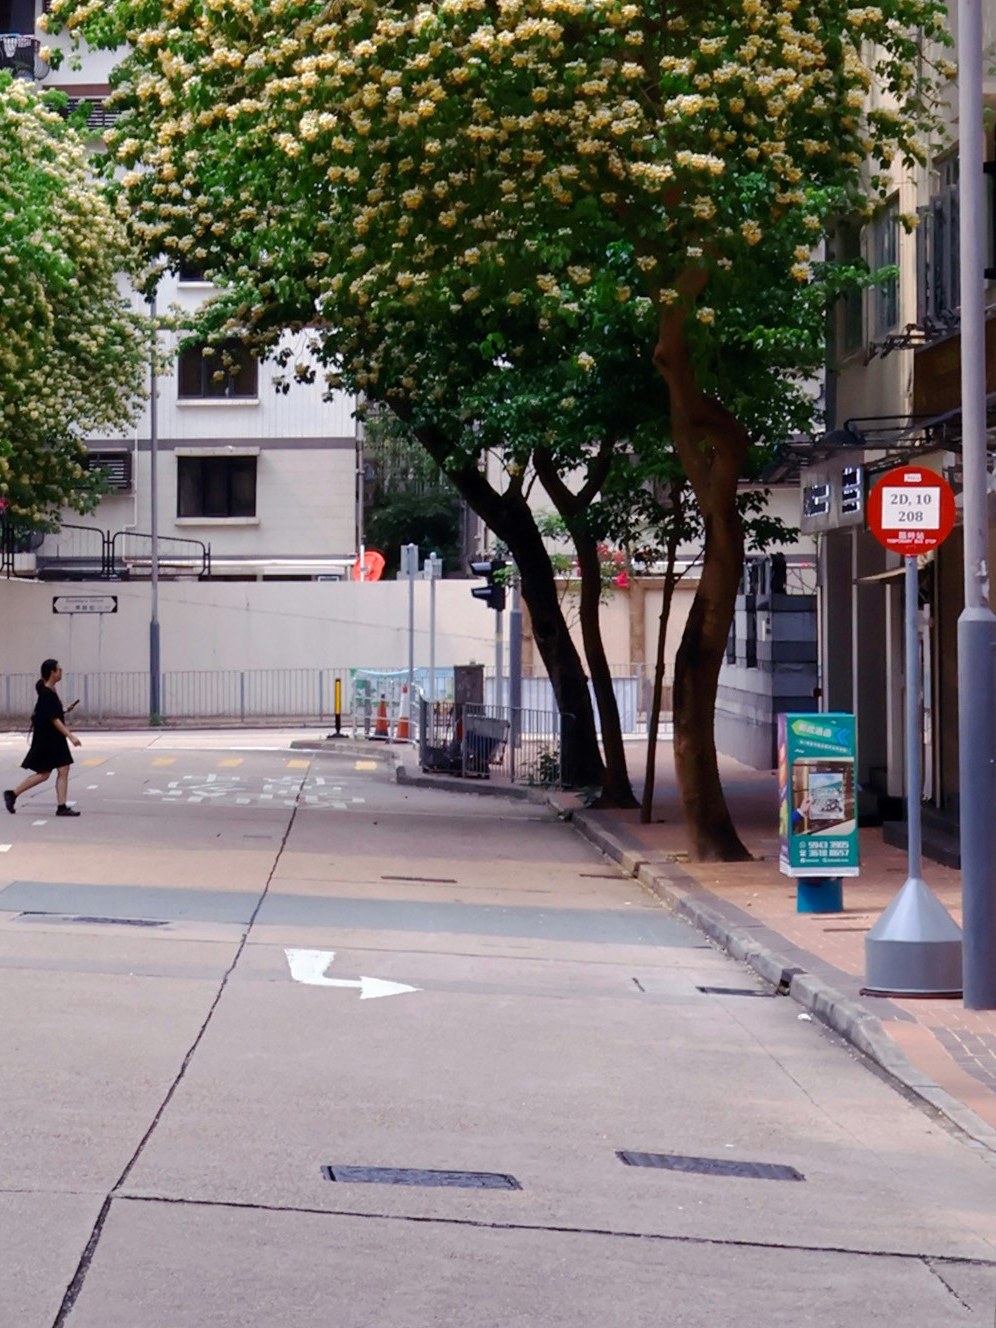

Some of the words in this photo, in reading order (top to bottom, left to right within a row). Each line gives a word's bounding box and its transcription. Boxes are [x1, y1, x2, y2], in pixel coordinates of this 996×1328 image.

[890, 494, 912, 506] 2D,
[916, 494, 932, 505] 10
[898, 511, 924, 522] 208
